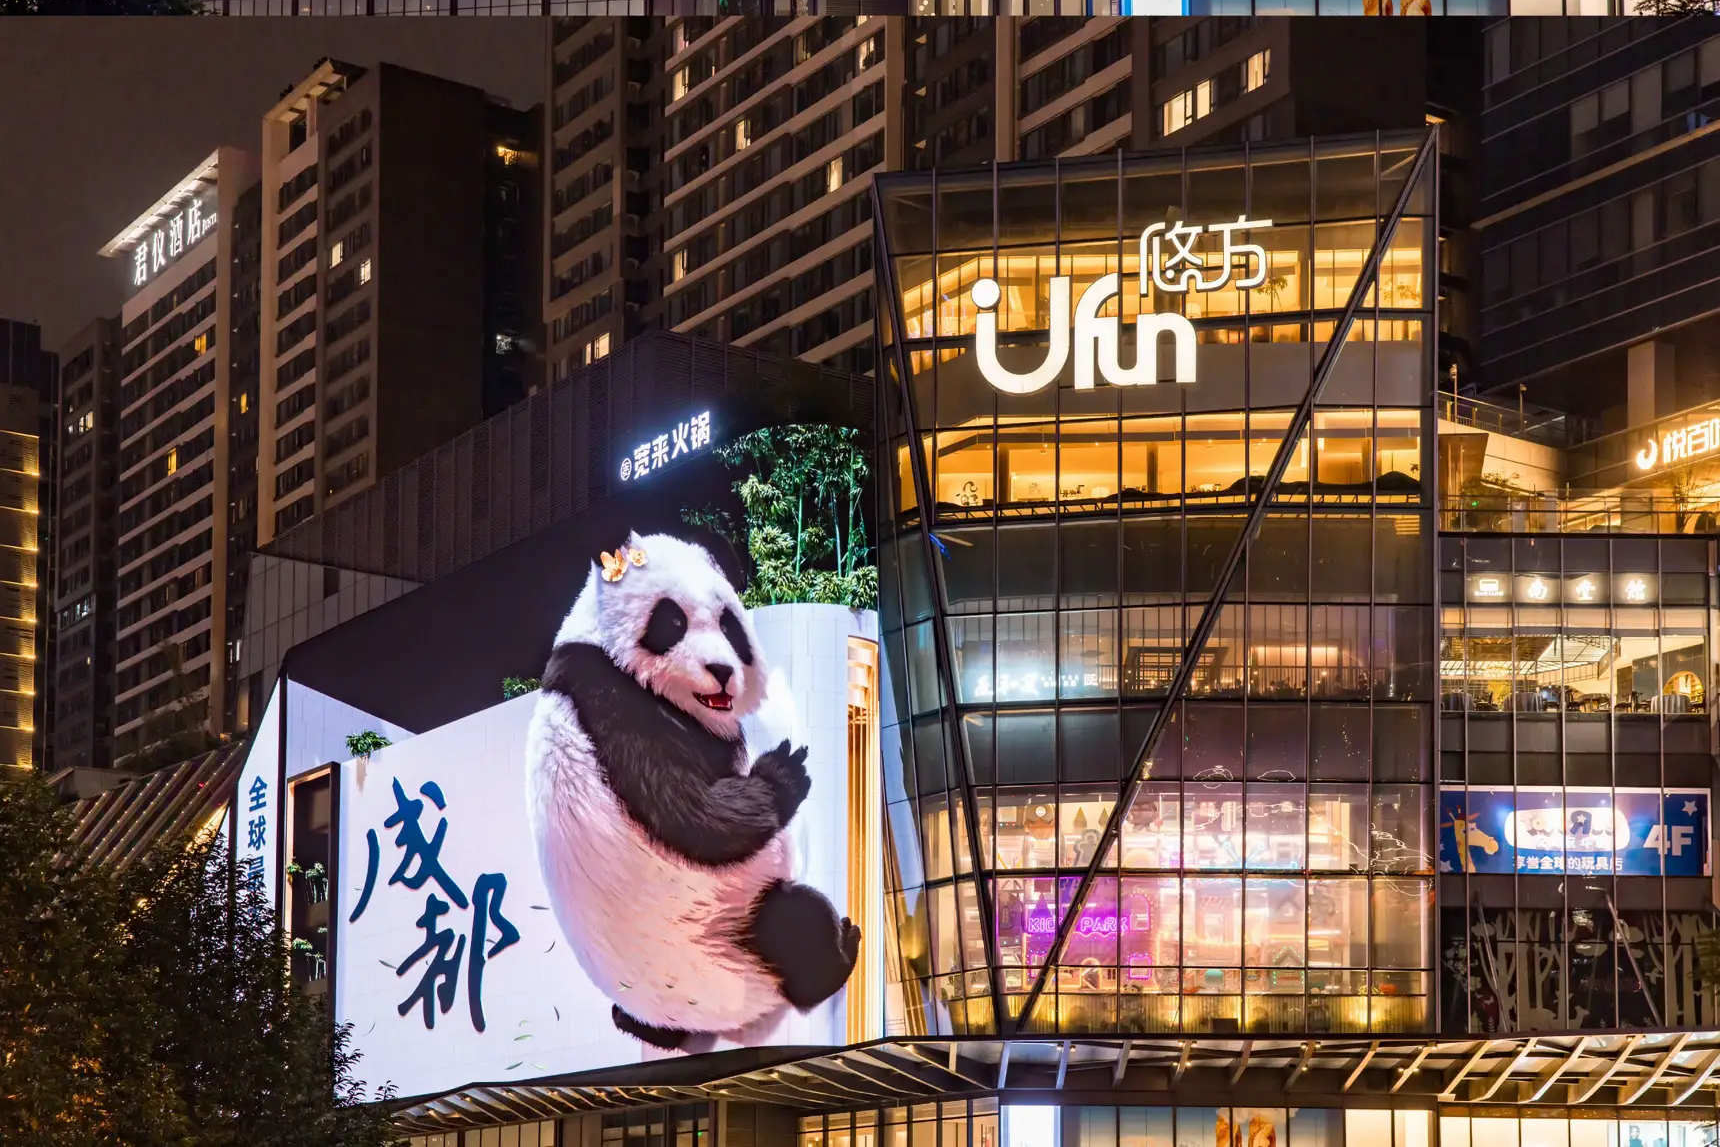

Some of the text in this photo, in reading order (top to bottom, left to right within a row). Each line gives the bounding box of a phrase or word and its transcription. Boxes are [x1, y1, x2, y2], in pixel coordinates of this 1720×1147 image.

[134, 199, 203, 286] 君仪酒店
[1140, 215, 1273, 297] 悠方
[633, 411, 710, 480] 宽来火锅
[1643, 824, 1694, 856] 4F
[349, 776, 521, 1033] 成都
[1081, 917, 1128, 932] PARK
